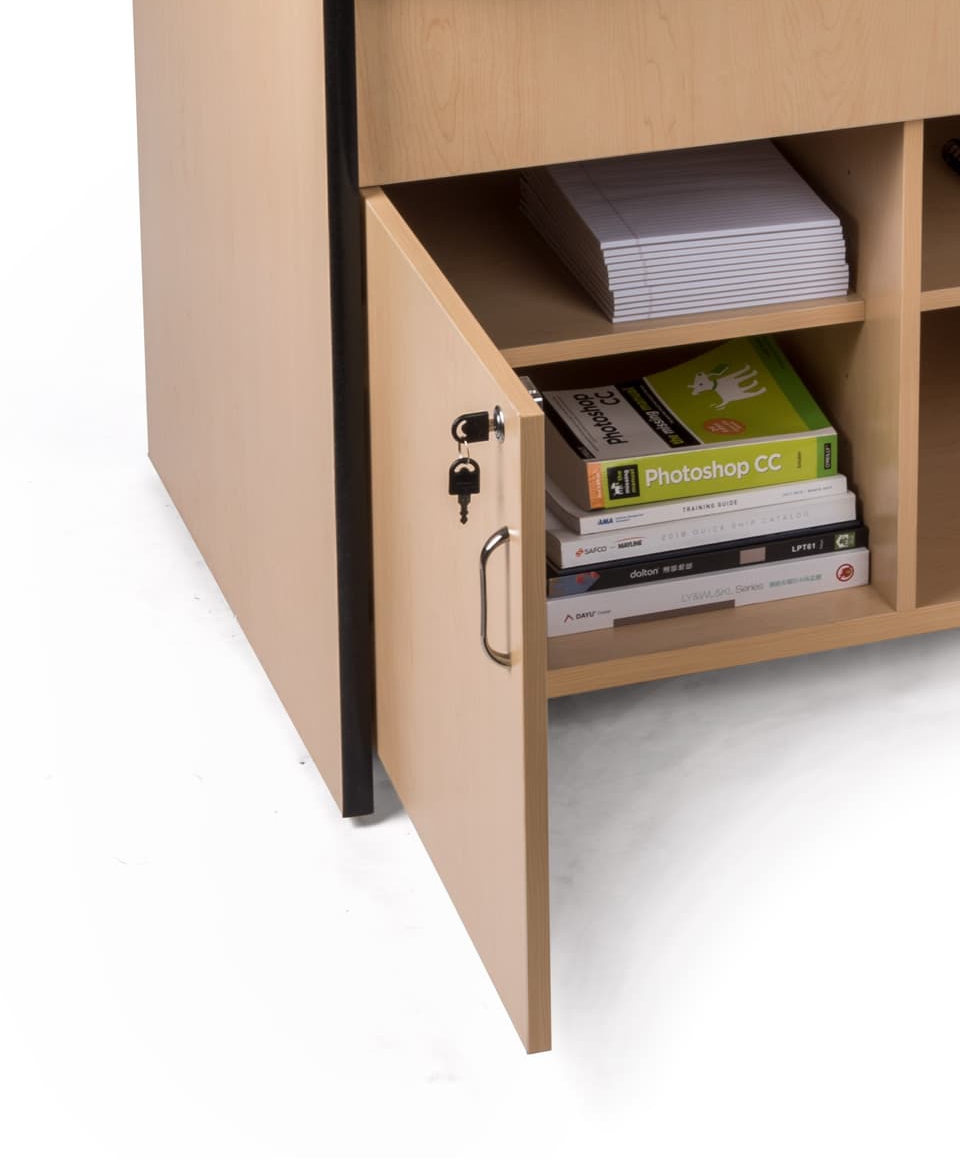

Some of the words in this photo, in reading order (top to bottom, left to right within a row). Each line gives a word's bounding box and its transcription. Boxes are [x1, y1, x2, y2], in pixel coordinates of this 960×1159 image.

[594, 390, 621, 406] CC
[573, 393, 629, 446] Photoshop
[645, 459, 750, 487] Photoshop
[754, 452, 783, 473] CC
[682, 502, 716, 513] TRAINING
[717, 499, 738, 509] GUIDE
[791, 542, 816, 553] LPT61
[630, 567, 659, 579] dalton
